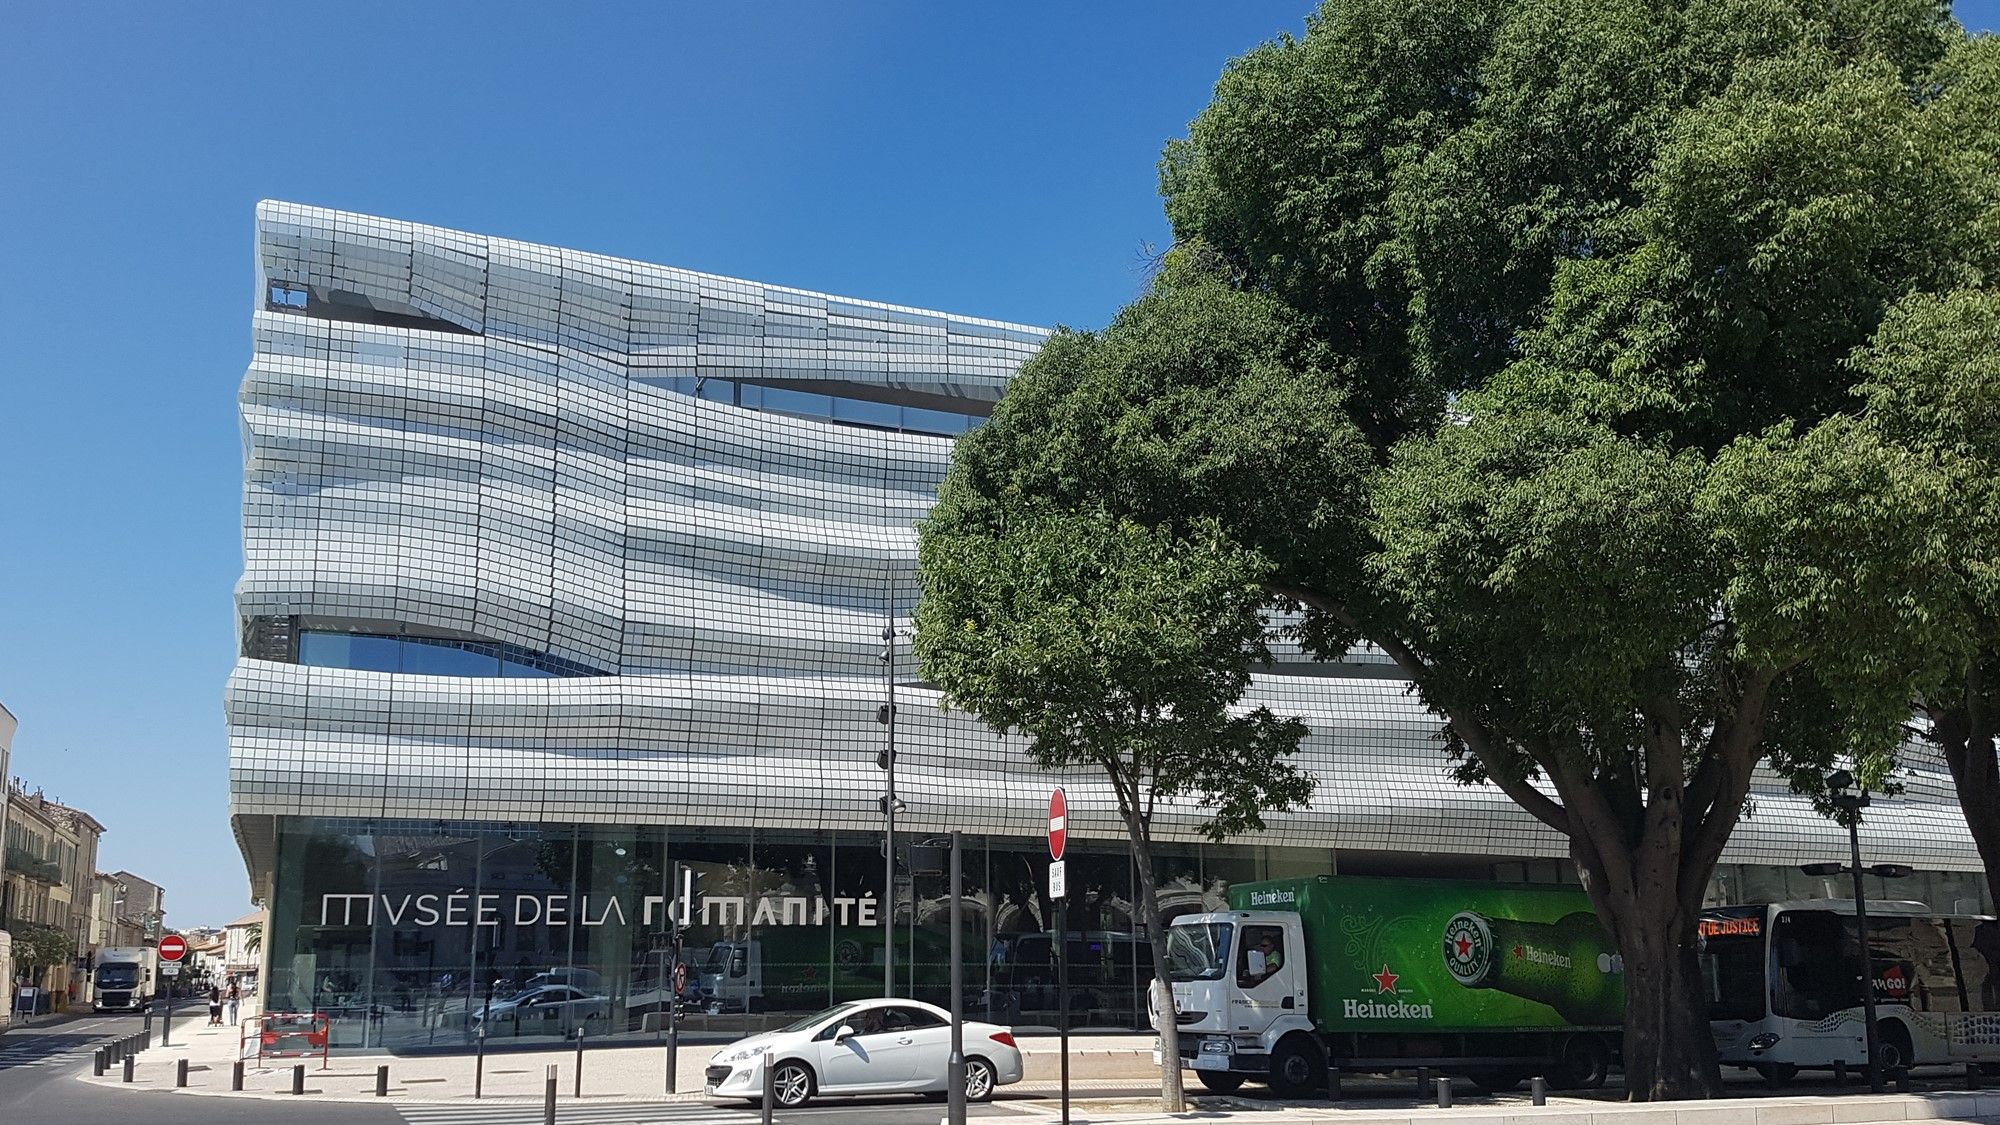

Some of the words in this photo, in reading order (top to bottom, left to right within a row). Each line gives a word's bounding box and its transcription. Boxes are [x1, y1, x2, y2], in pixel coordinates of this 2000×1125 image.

[1250, 889, 1294, 906] Heineken
[515, 895, 568, 926] DE
[581, 895, 626, 926] LA
[1445, 919, 1482, 947] Heineken
[1720, 917, 1760, 934] JUSTICE
[1449, 956, 1480, 976] QUALITY
[1526, 945, 1571, 969] Heineken
[1342, 999, 1434, 1019] Heineken
